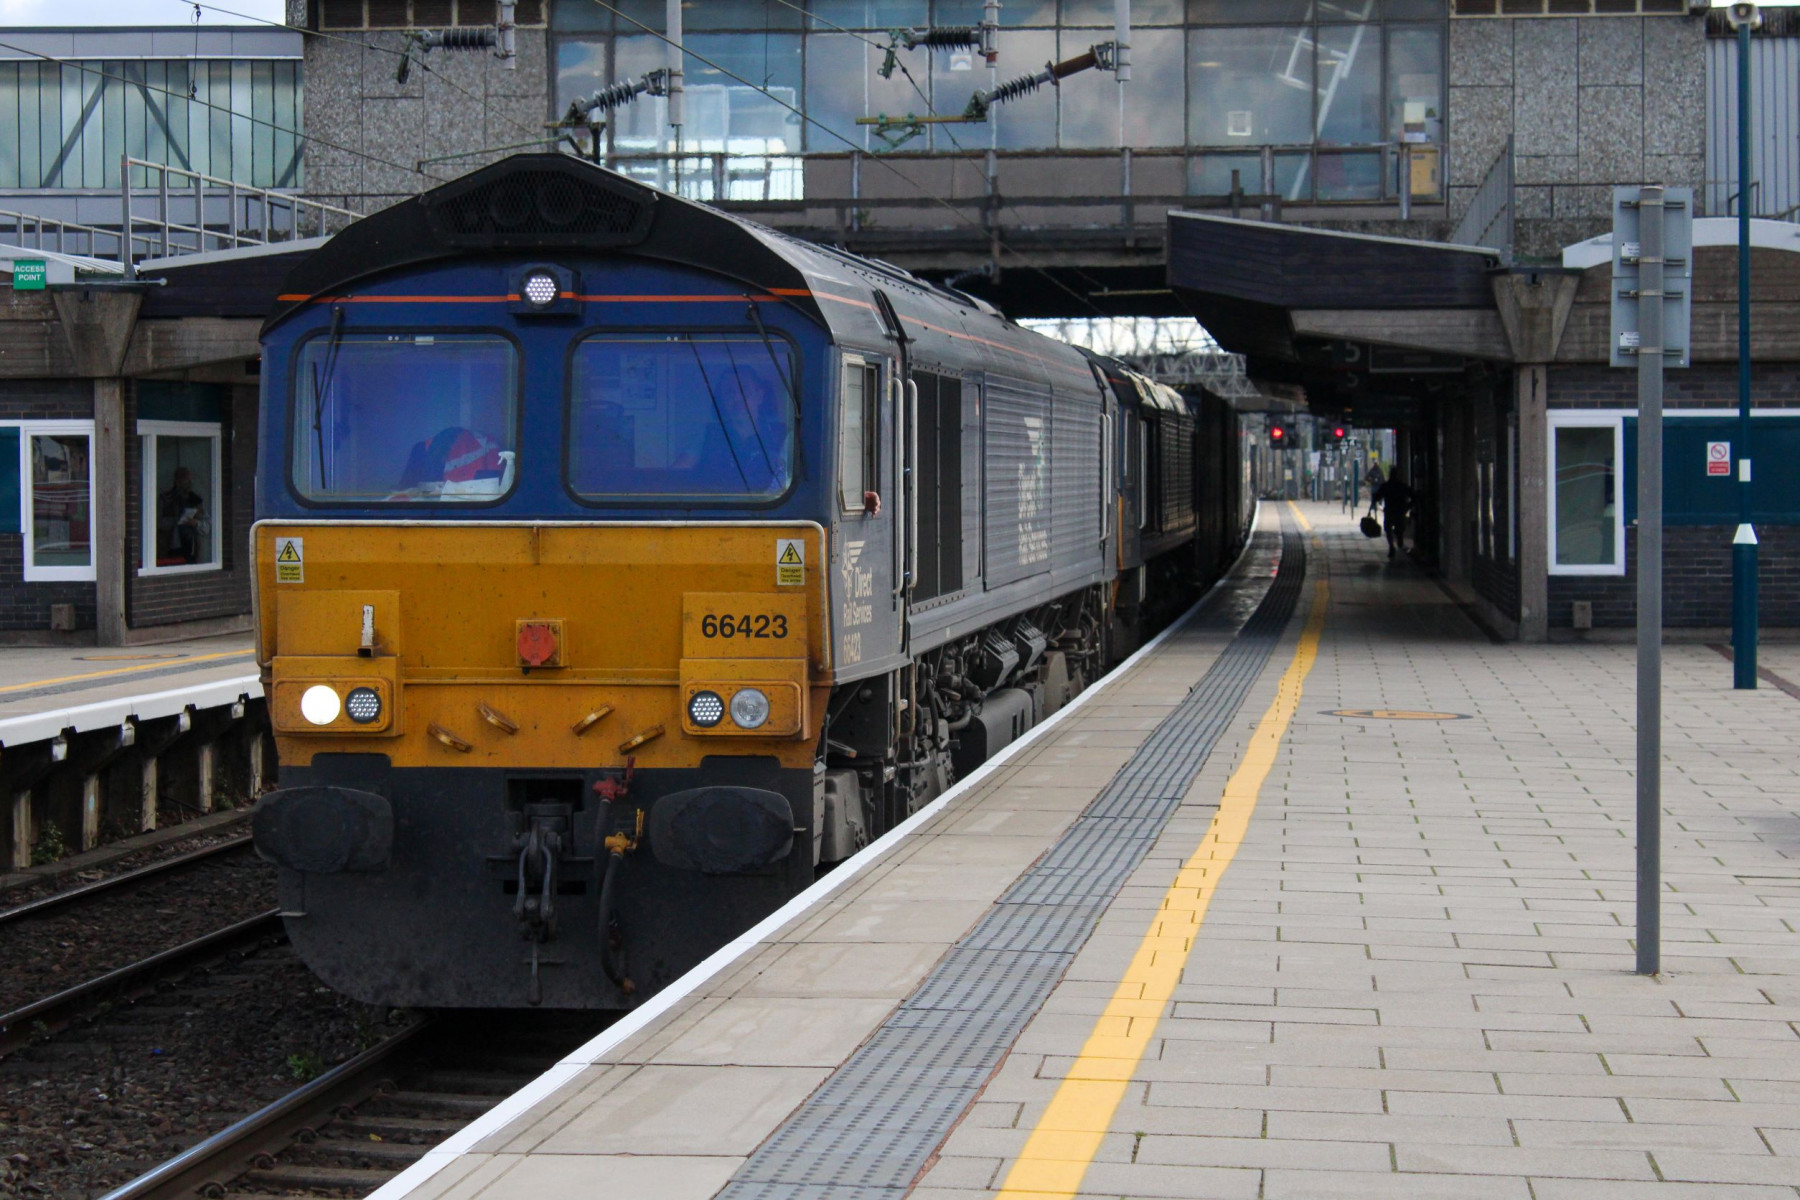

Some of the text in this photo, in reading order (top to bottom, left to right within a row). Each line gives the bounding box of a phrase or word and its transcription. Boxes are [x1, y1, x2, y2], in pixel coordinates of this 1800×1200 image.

[15, 265, 45, 273] ACCESS
[855, 566, 872, 597] Direct
[702, 614, 788, 638] 66423
[844, 600, 872, 627] Rail Services
[844, 632, 861, 664] 66423
